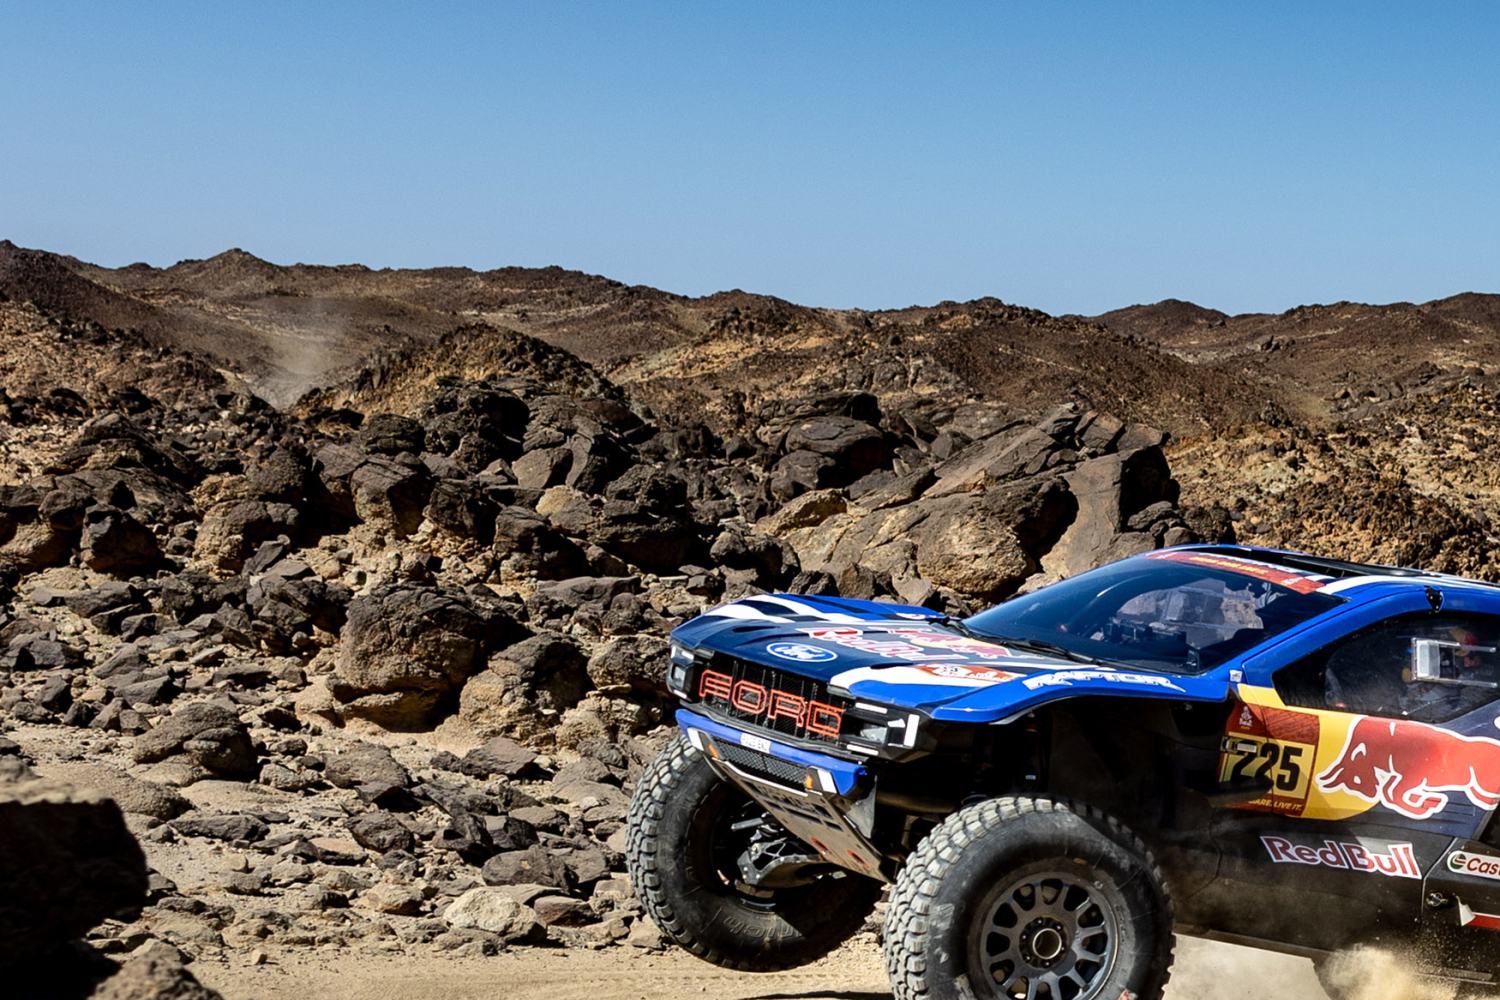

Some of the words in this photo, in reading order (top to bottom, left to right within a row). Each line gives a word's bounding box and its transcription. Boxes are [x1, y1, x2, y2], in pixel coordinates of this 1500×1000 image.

[699, 669, 847, 739] FORD
[1022, 670, 1186, 692] RAPTOR
[1230, 741, 1303, 792] 225
[1260, 836, 1349, 868] Red
[1341, 843, 1421, 879] Bull
